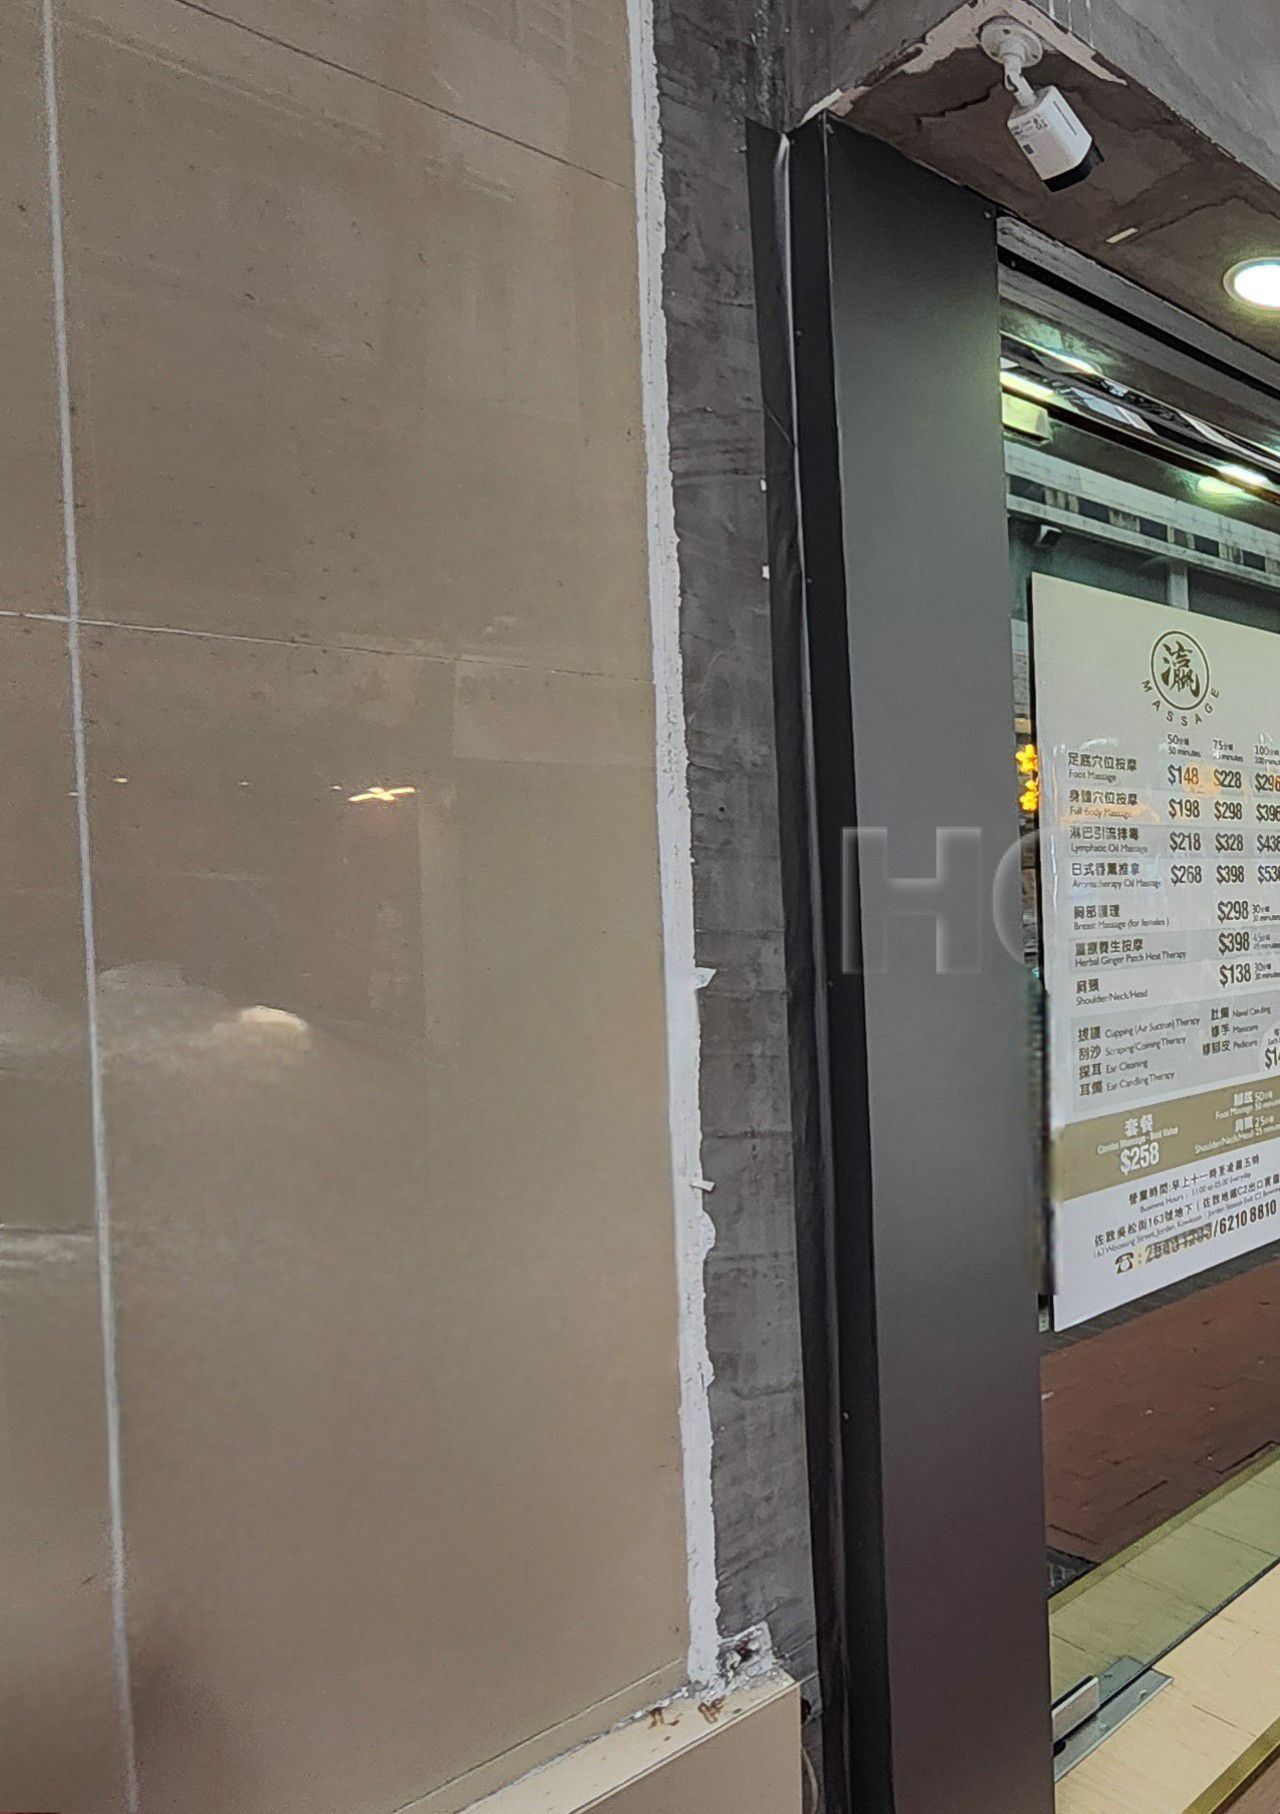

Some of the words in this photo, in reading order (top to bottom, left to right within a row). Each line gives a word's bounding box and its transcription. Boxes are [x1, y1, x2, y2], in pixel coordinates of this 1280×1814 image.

[1141, 679, 1219, 727] MASSAGE
[1167, 763, 1200, 785] $148
[1213, 768, 1242, 789] $228
[1168, 798, 1200, 819] $198
[1214, 800, 1243, 821] $298
[1169, 830, 1202, 853] $218
[1215, 833, 1244, 853] $328
[1170, 864, 1202, 887] $268
[1216, 864, 1245, 885] $398
[1217, 900, 1249, 924] $298
[1218, 931, 1251, 956] $398
[1219, 962, 1251, 988] $138
[1120, 1141, 1160, 1176] $258
[1249, 1198, 1277, 1223] 8810
